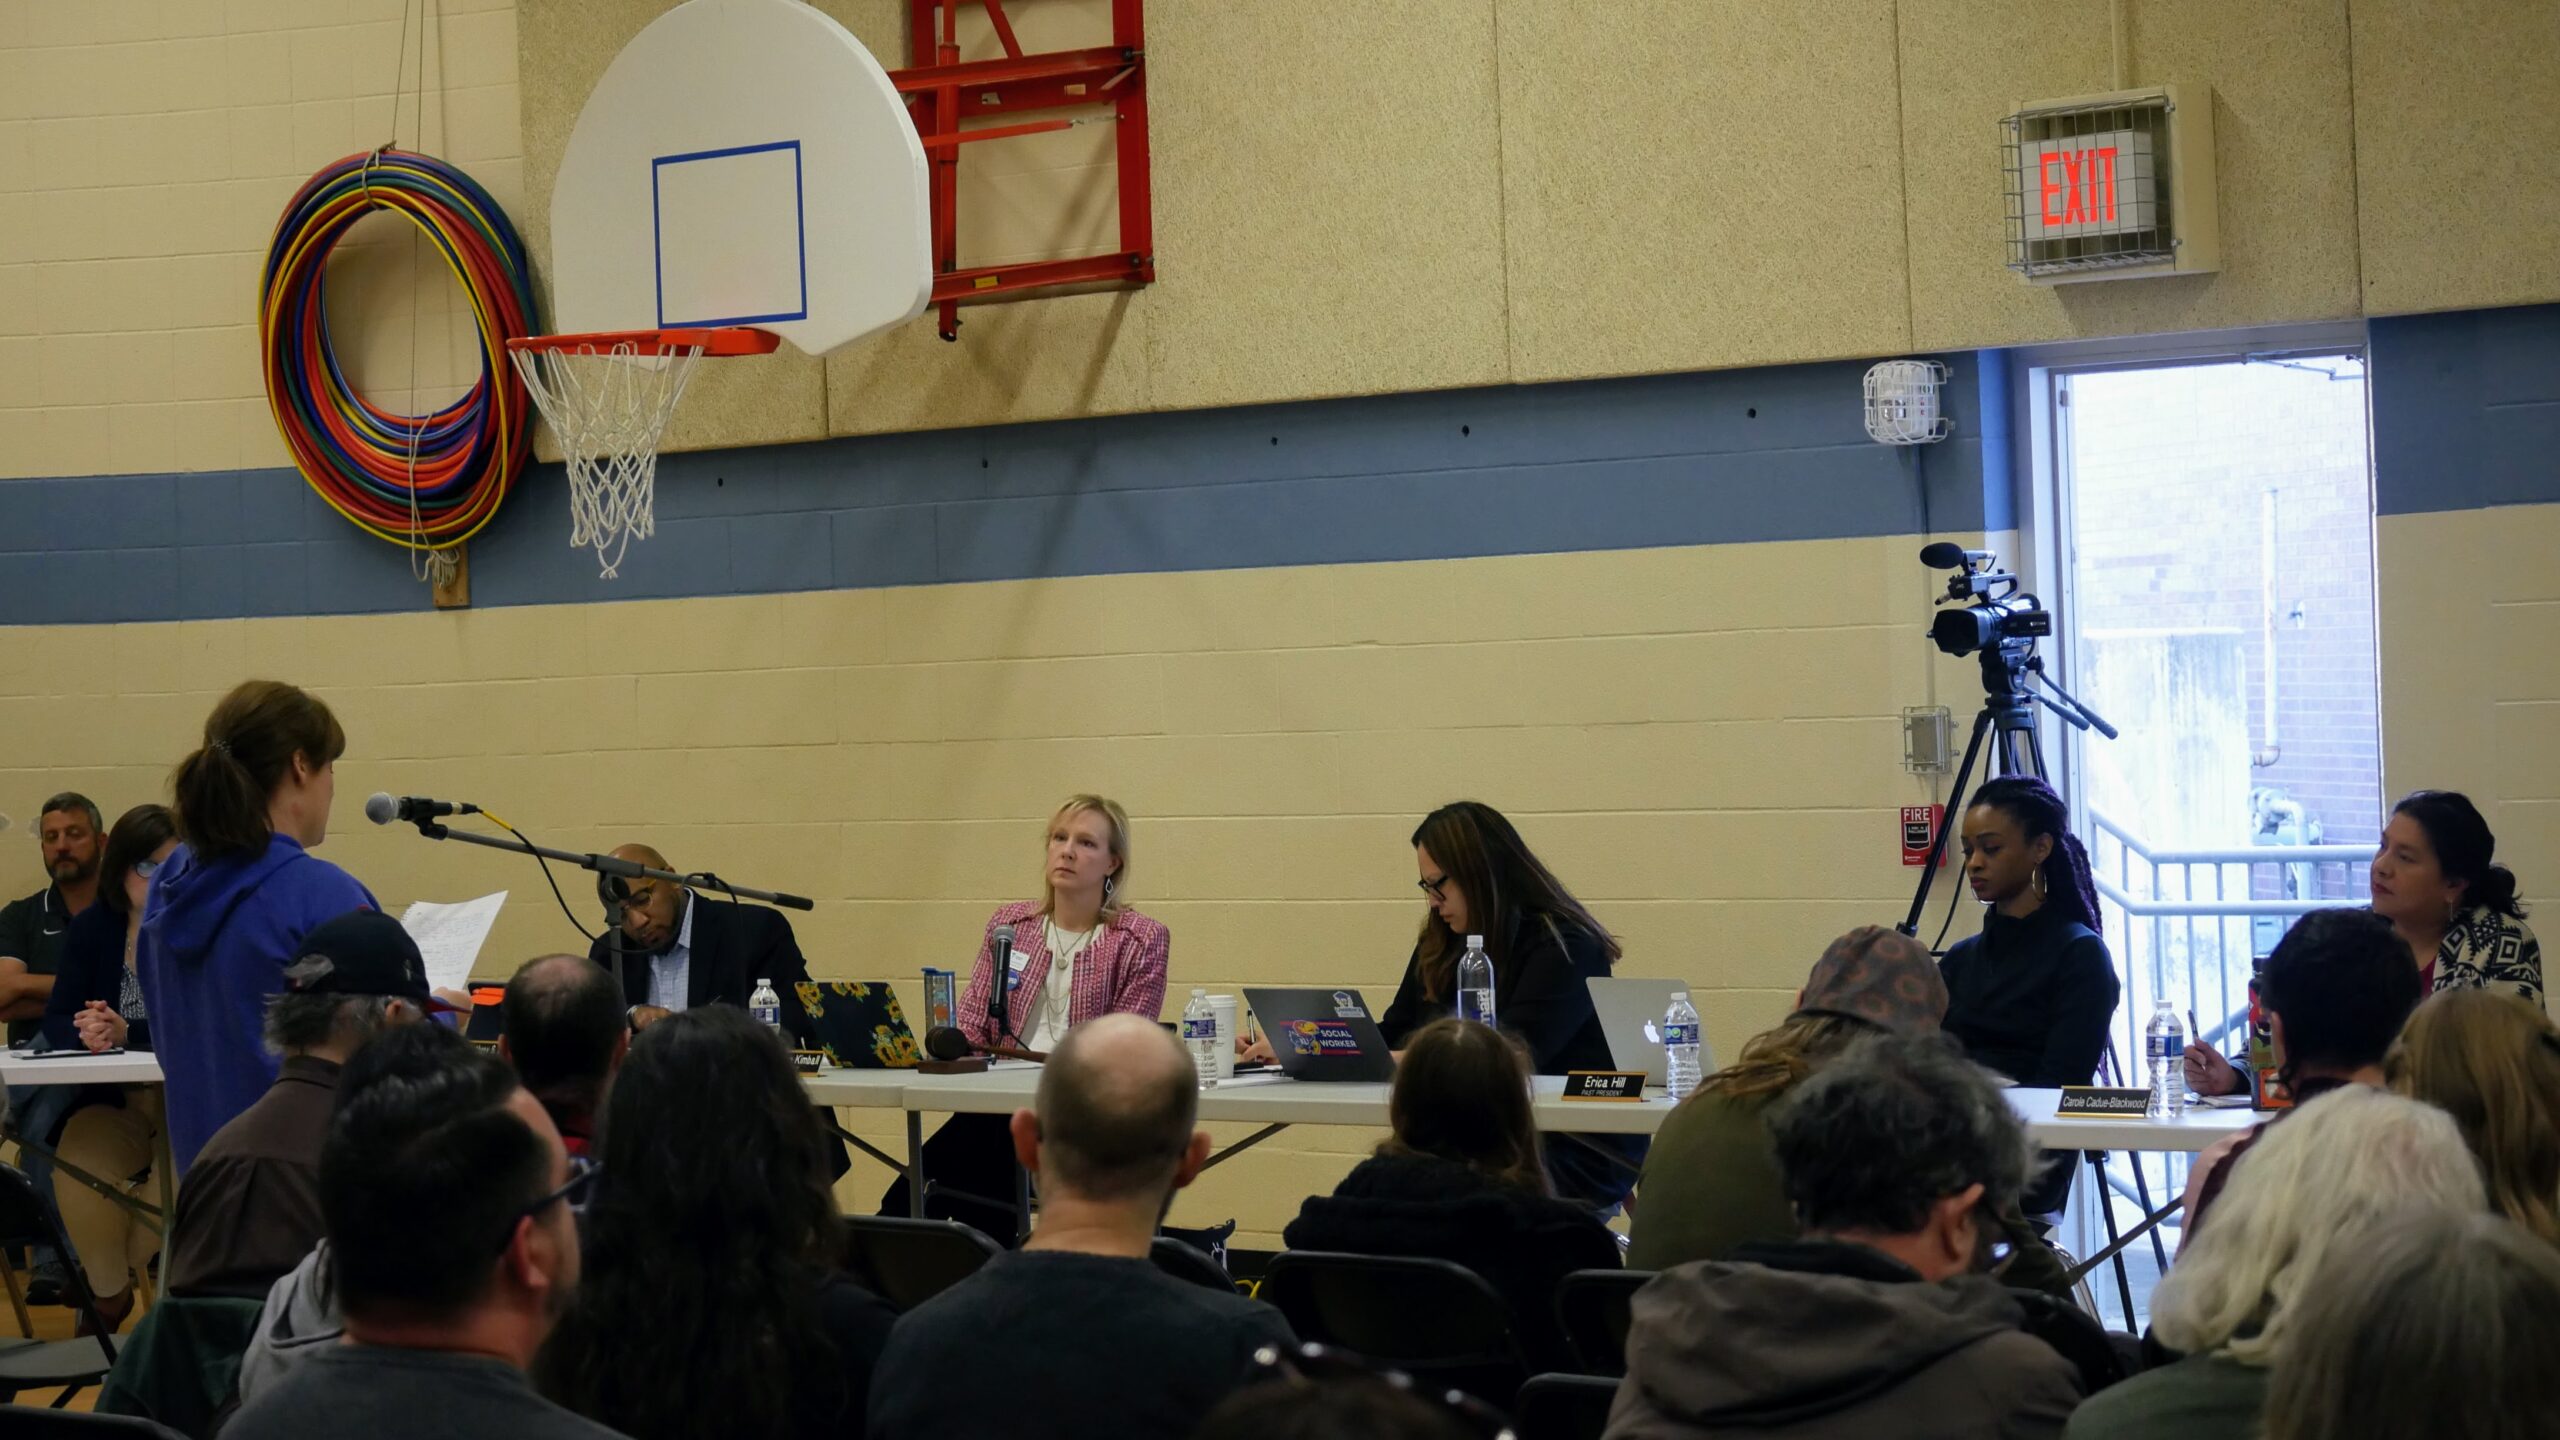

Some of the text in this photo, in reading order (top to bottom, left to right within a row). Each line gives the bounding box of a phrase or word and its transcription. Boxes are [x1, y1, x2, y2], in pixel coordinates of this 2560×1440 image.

[2040, 146, 2118, 226] EXIT
[1904, 808, 1930, 821] FIRE
[1477, 988, 1490, 1024] mart
[1320, 1030, 1352, 1038] SOCIAL
[1320, 1040, 1357, 1048] WORKER
[793, 1054, 821, 1065] Kimball
[1584, 1075, 1627, 1089] Erica Hill
[2063, 1096, 2146, 1109] Carole Cadue-Blackwood
